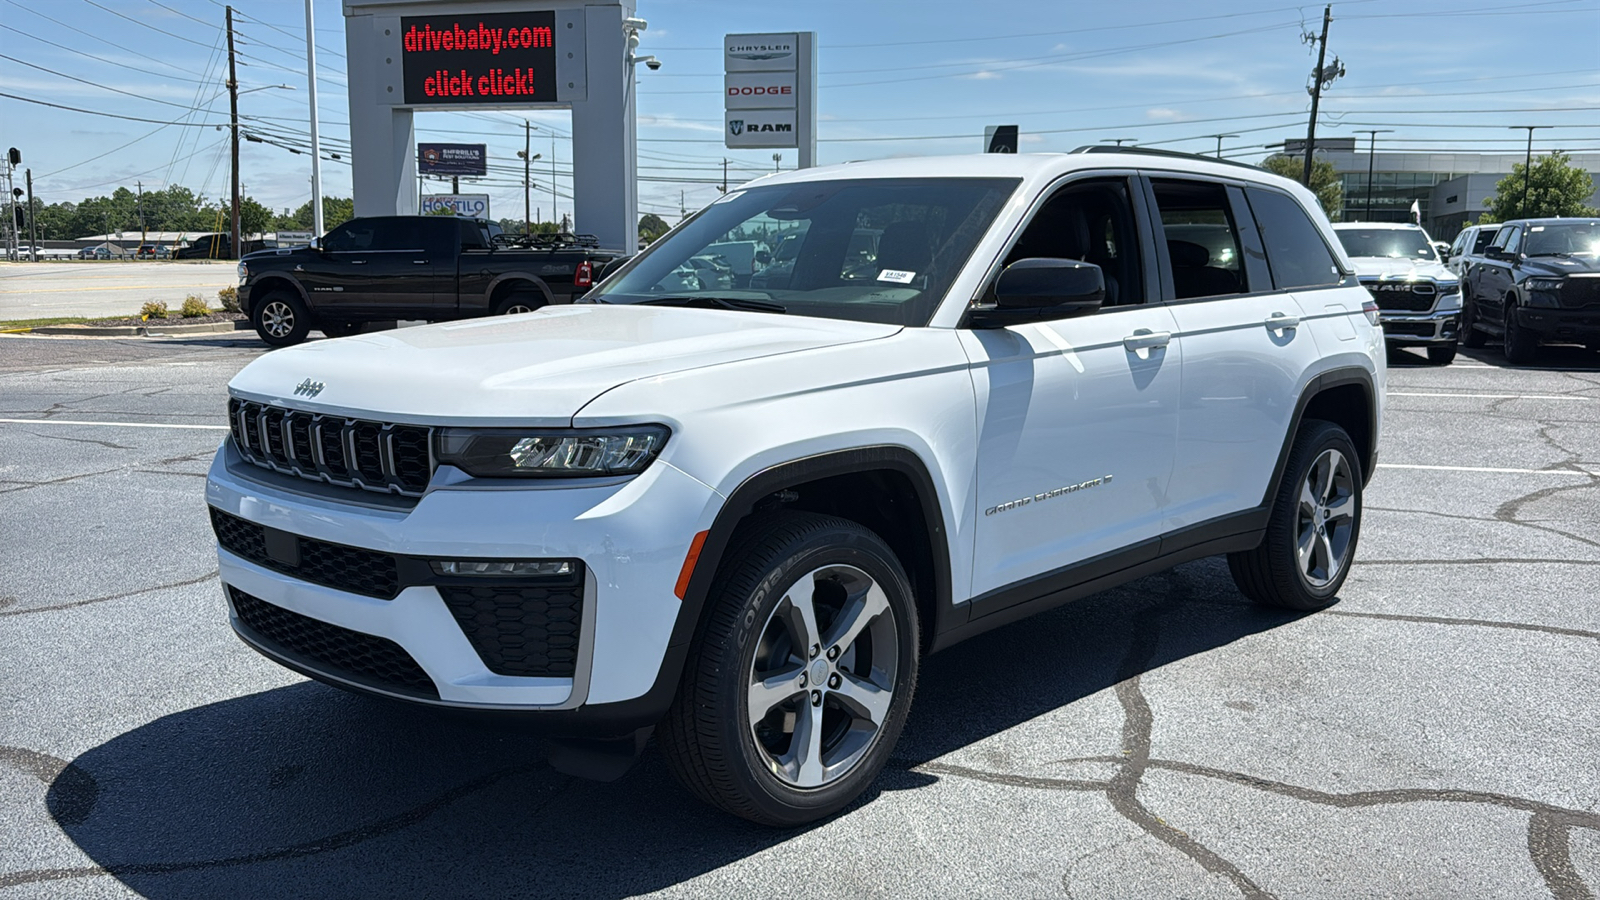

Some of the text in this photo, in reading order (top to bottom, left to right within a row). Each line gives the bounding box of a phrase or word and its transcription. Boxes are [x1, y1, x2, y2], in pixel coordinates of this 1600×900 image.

[404, 21, 552, 55] drivebaby.com
[424, 67, 535, 97] click click!
[728, 86, 792, 96] DODGE
[747, 124, 792, 132] RAM
[422, 200, 485, 212] HOSTILO
[985, 477, 1102, 516] GRAND CHEROKEE
